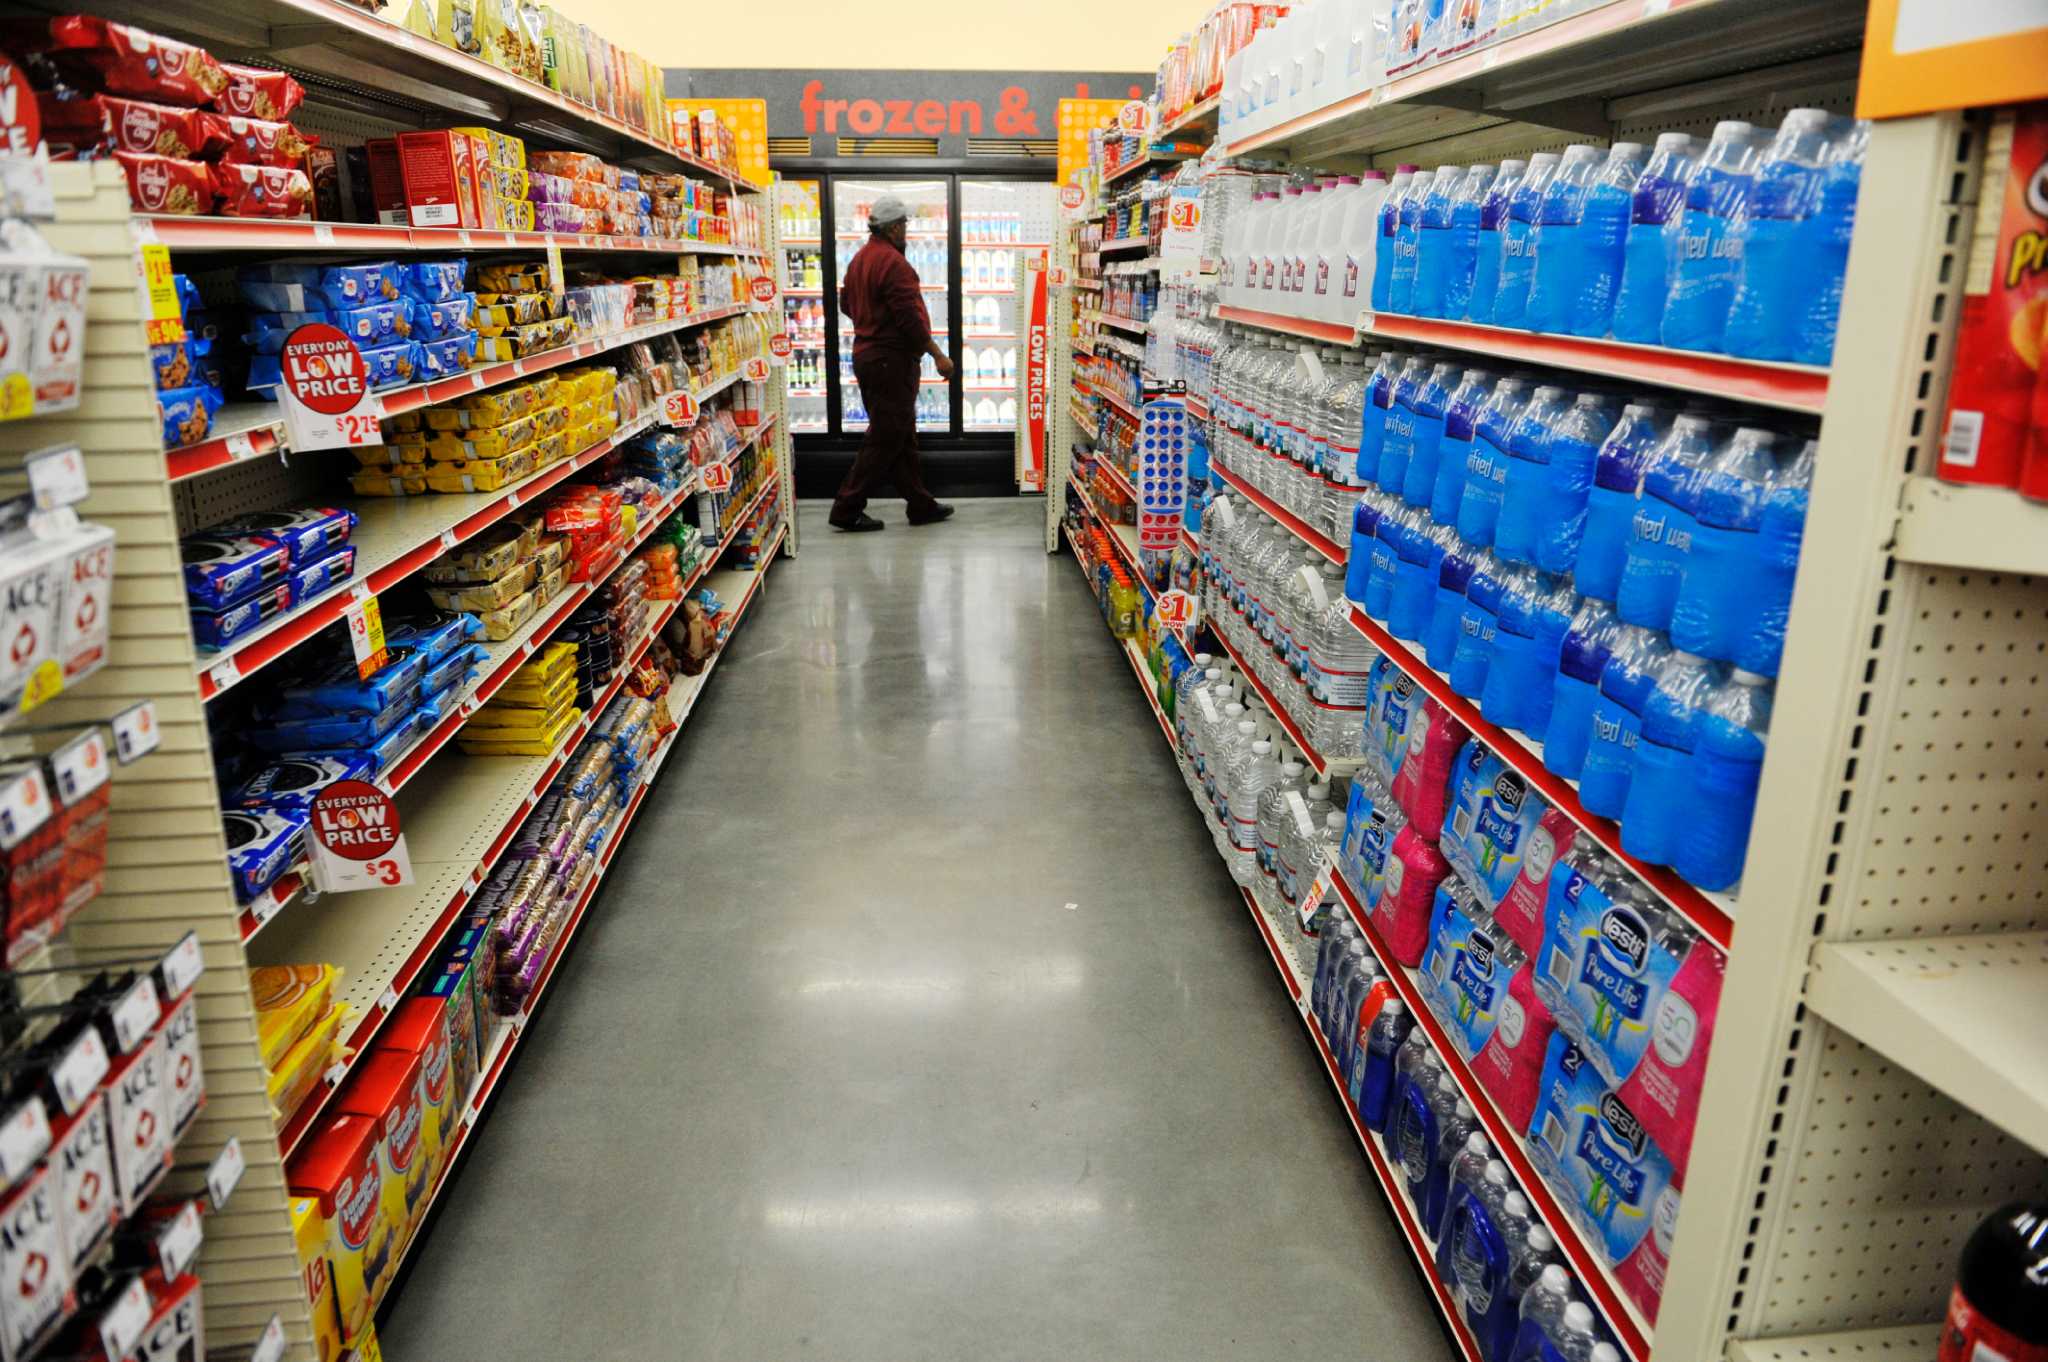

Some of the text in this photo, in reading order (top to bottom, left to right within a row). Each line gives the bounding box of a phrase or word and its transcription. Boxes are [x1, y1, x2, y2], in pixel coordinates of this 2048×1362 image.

[800, 80, 983, 135] frozen
[994, 86, 1040, 135] &
[1172, 203, 1196, 227] $1
[289, 351, 353, 381] LOW
[1029, 325, 1045, 421] LOW PRICES
[295, 376, 362, 398] PRICE
[667, 394, 694, 421] $1
[704, 464, 728, 487] $1
[1160, 596, 1187, 621] $1
[320, 805, 387, 831] LOW
[324, 826, 395, 847] PRICE
[366, 859, 402, 886] $3
[1585, 952, 1642, 1010] Pure Life
